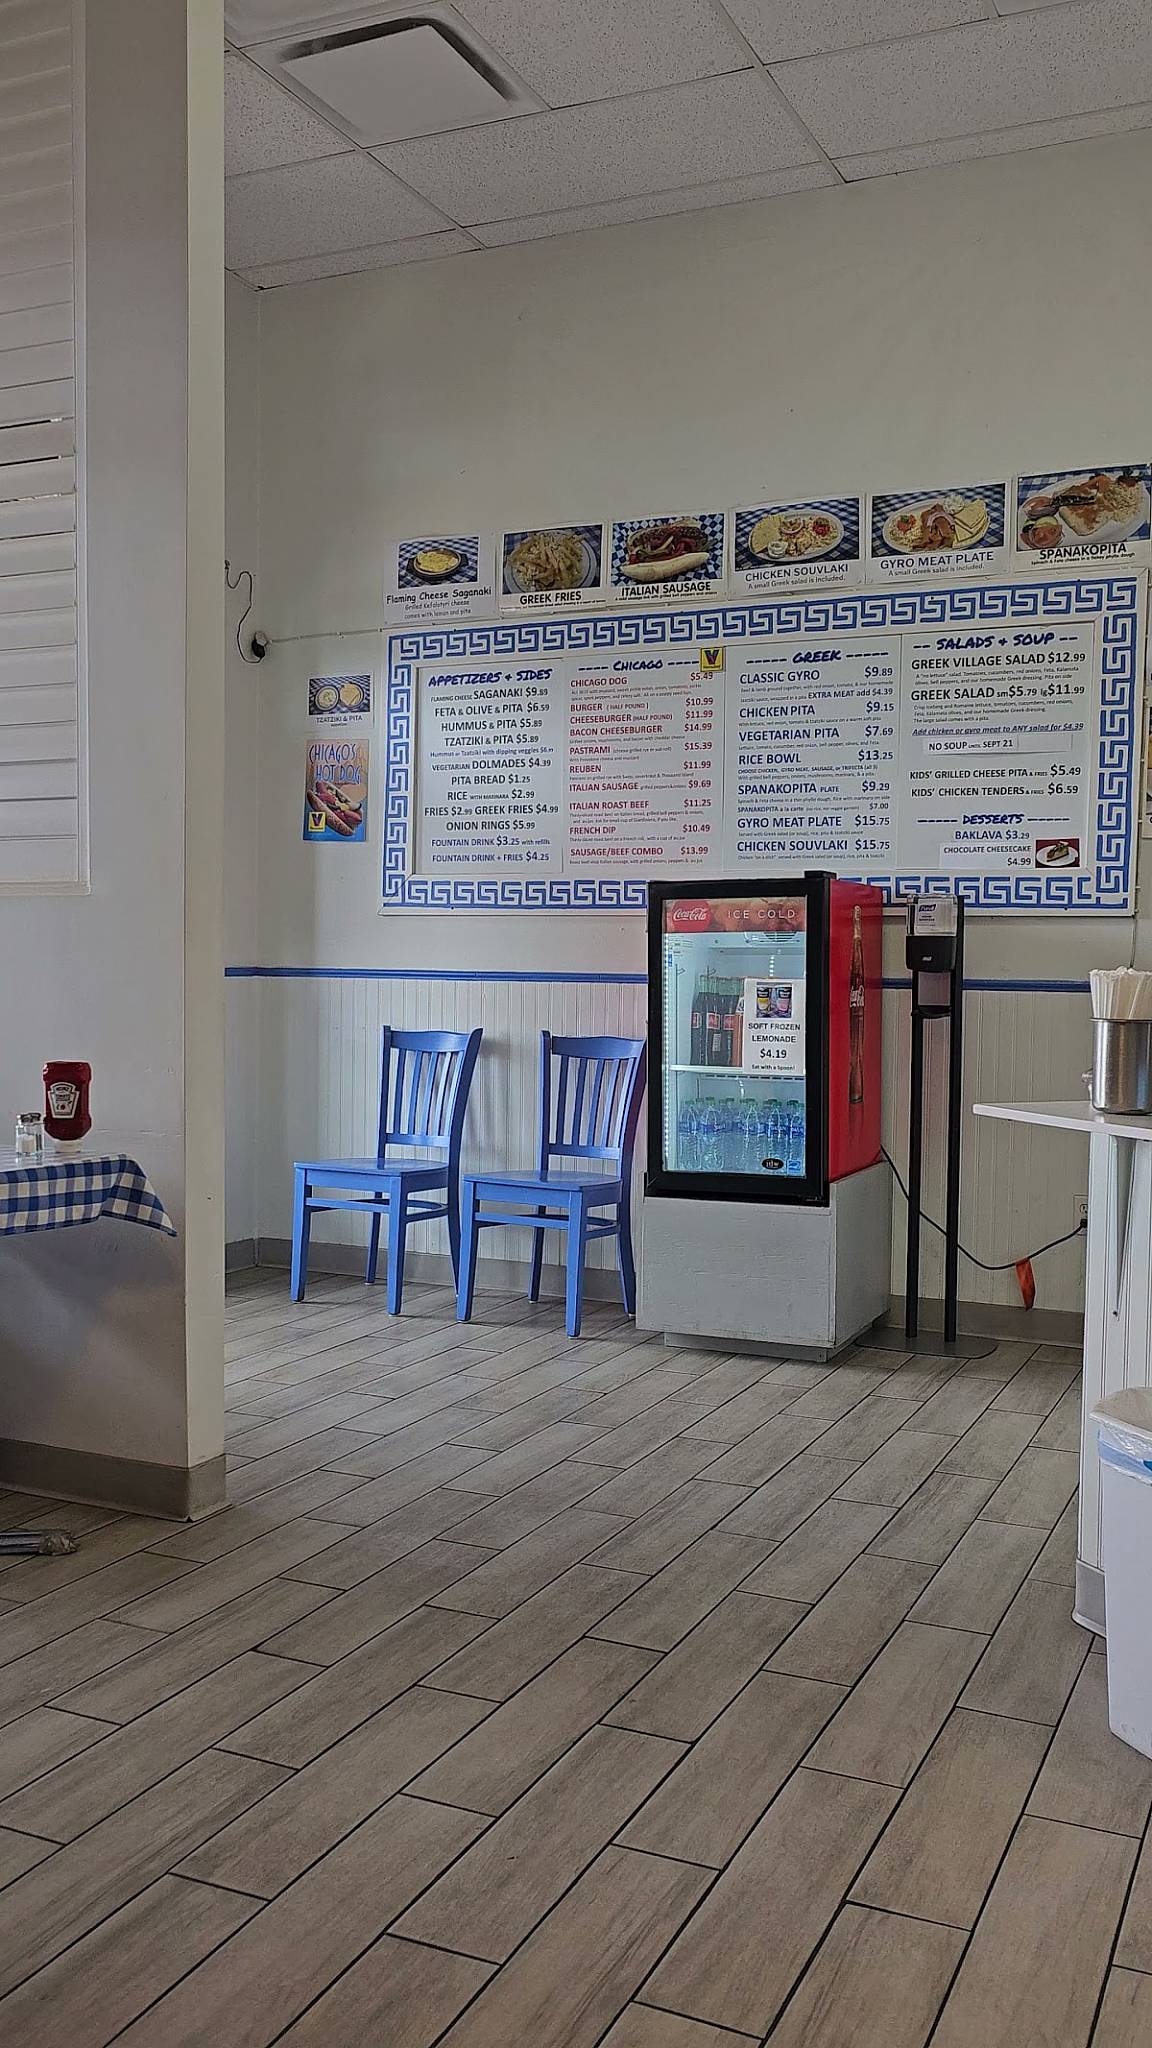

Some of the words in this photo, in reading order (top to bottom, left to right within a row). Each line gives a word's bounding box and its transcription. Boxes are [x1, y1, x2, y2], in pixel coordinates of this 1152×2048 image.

[1040, 543, 1126, 559] SPANAKOPITA
[881, 558, 915, 570] GYRO
[918, 555, 954, 567] MEAT
[955, 551, 993, 563] PLATE
[746, 568, 791, 582] CHICKEN
[794, 564, 848, 575] SOUVLAKI
[622, 584, 661, 597] ITALIAN
[663, 582, 711, 593] SAUSAGE
[754, 580, 770, 589] small
[771, 579, 789, 587] Greek
[387, 594, 416, 604] Flaming
[419, 592, 448, 600] Cheese
[452, 586, 491, 599] Saganaki
[520, 593, 553, 605] GREEK
[555, 590, 582, 601] FRIES
[936, 635, 995, 650] SALADS
[1013, 632, 1055, 646] SOUP
[792, 650, 841, 664] GREEK
[912, 659, 950, 670] GREEK
[953, 655, 1002, 668] VILLAGE
[1005, 653, 1045, 665] SALAD
[1048, 651, 1086, 664] $12.99
[613, 659, 663, 671] CHICAGO
[428, 671, 502, 687] APPETIZERS
[516, 668, 553, 681] SIDES
[570, 679, 607, 688] CHICAGO
[609, 677, 627, 685] DOG
[690, 672, 713, 681] $5.49
[740, 671, 785, 684] CLASSIC
[787, 670, 820, 682] GYRO
[865, 665, 893, 678] $9.89
[473, 688, 523, 700] SAGANAKI
[525, 686, 548, 698] $9.89
[808, 691, 832, 700] EXTRA
[834, 690, 854, 698] MEAT
[872, 688, 893, 696] $4.39
[911, 690, 950, 701] GREEK
[954, 688, 995, 699] SALAD
[435, 707, 456, 717] FETA
[465, 705, 492, 715] OLIVE
[503, 704, 523, 713] PITA
[527, 702, 550, 713] $6.59
[570, 704, 603, 712] BURGER
[686, 697, 713, 706] $10.99
[739, 707, 788, 718] CHICKEN
[790, 705, 815, 715] PITA
[866, 701, 894, 714] $9.15
[570, 714, 632, 724] CHEESEBURGER
[685, 710, 713, 719] $11.99
[441, 721, 487, 732] HUMMUS
[497, 720, 517, 729] PITA
[570, 729, 597, 737] BACON
[600, 725, 662, 735] CHEESEBURGER
[684, 723, 712, 732] $14.99
[445, 737, 483, 747] TZATZIKI
[493, 735, 513, 744] PITA
[516, 734, 539, 744] $5.89
[739, 729, 811, 742] VEGETARIAN
[814, 728, 839, 738] PITA
[865, 725, 893, 737] $7.69
[570, 746, 610, 755] PASTRAMI
[684, 742, 712, 751] $15.39
[929, 742, 942, 751] NO
[944, 742, 968, 750] SOUP
[983, 740, 1000, 748] SEPT
[1002, 739, 1013, 748] 21
[472, 759, 525, 769] DOLMADES
[529, 758, 551, 768] $4.39
[739, 754, 763, 765] RICE
[767, 753, 801, 764] BOWL
[858, 750, 893, 762] $13.25
[316, 765, 335, 781] HOT
[340, 764, 361, 784] DOG
[570, 765, 601, 773] REUBEN
[684, 761, 711, 770] $11.99
[934, 770, 970, 779] GRILLED
[973, 769, 1006, 778] CHEESE
[1008, 769, 1028, 778] PITA
[1050, 764, 1081, 777] $5.49
[452, 776, 471, 785] PITA
[474, 775, 505, 784] BREAD
[508, 773, 531, 784] $1.25
[570, 784, 600, 792] ITALIAN
[601, 782, 638, 791] SAUSAGE
[688, 780, 711, 788] $9.69
[738, 783, 817, 795] SPANAKOPITA
[862, 780, 890, 793] $9.29
[939, 788, 979, 796] CHICKEN
[982, 787, 1024, 796] TENDERS
[1048, 782, 1078, 795] $6.59
[424, 807, 448, 816] FRIES
[451, 806, 472, 816] $2.99
[475, 805, 505, 815] GREEK
[508, 805, 533, 814] FRIES
[536, 803, 559, 814] $4.99
[570, 801, 600, 810] ITALIAN
[602, 801, 627, 809] ROAST
[630, 800, 649, 809] BEEF
[684, 799, 711, 807] $11.25
[446, 822, 478, 831] ONION
[481, 821, 510, 830] RINGS
[513, 820, 535, 830] $5.99
[738, 817, 769, 828] GYRO
[773, 817, 805, 828] MEAT
[808, 816, 842, 827] PLATE
[855, 814, 890, 827] $15.75
[962, 814, 1025, 825] DESSERTS
[570, 827, 600, 835] FRENCH
[603, 826, 616, 834] DIP
[682, 824, 710, 833] $10.49
[955, 831, 1002, 840] BAKLAVA
[1005, 830, 1030, 840] $3.29
[570, 847, 629, 857] SAUSAGE/BEEF
[632, 847, 663, 856] COMBO
[681, 847, 708, 856] $13.99
[737, 841, 785, 852] CHICKEN
[789, 840, 848, 851] SOUVLAKI
[855, 838, 890, 851] $15.75
[944, 846, 984, 854] CHOCOLATE
[986, 845, 1031, 853] CHEESECAKE
[1007, 858, 1031, 866] $4.99
[728, 909, 750, 919] ICE
[758, 909, 795, 918] COLD
[752, 1035, 796, 1043] LEMONADE
[760, 1048, 787, 1059] $4.19
